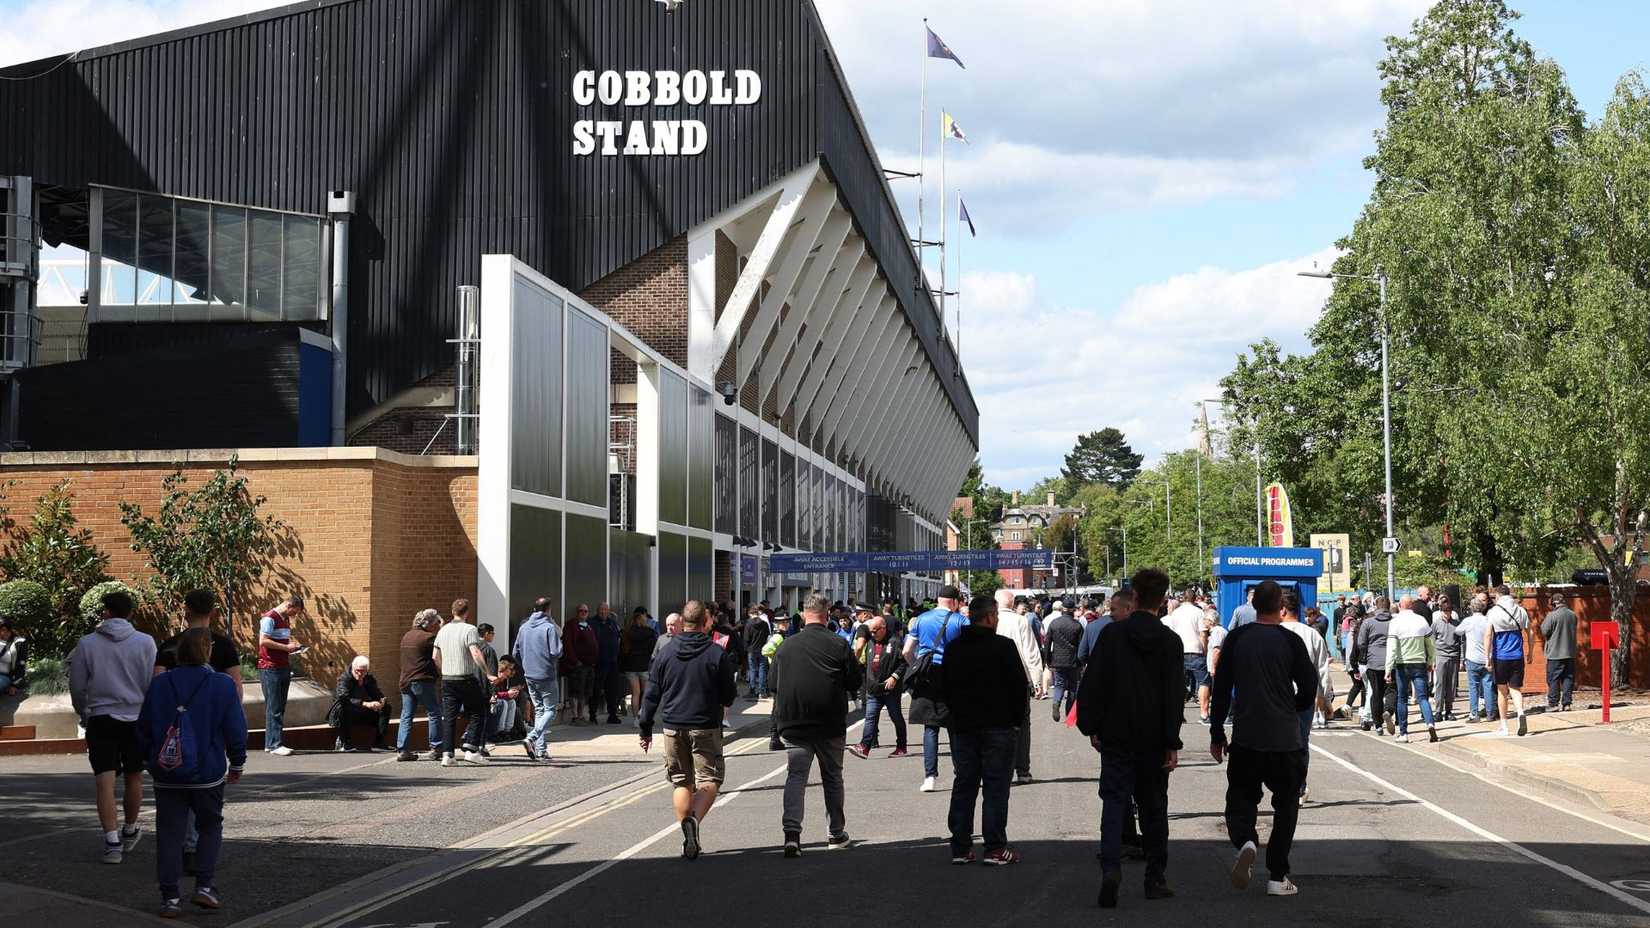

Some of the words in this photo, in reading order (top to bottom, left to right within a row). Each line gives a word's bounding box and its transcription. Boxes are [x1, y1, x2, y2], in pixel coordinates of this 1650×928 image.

[573, 69, 762, 106] COBBOLD
[573, 119, 708, 156] STAND
[1227, 557, 1260, 566] OFFICIAL
[1261, 557, 1314, 566] PROGRAMMES
